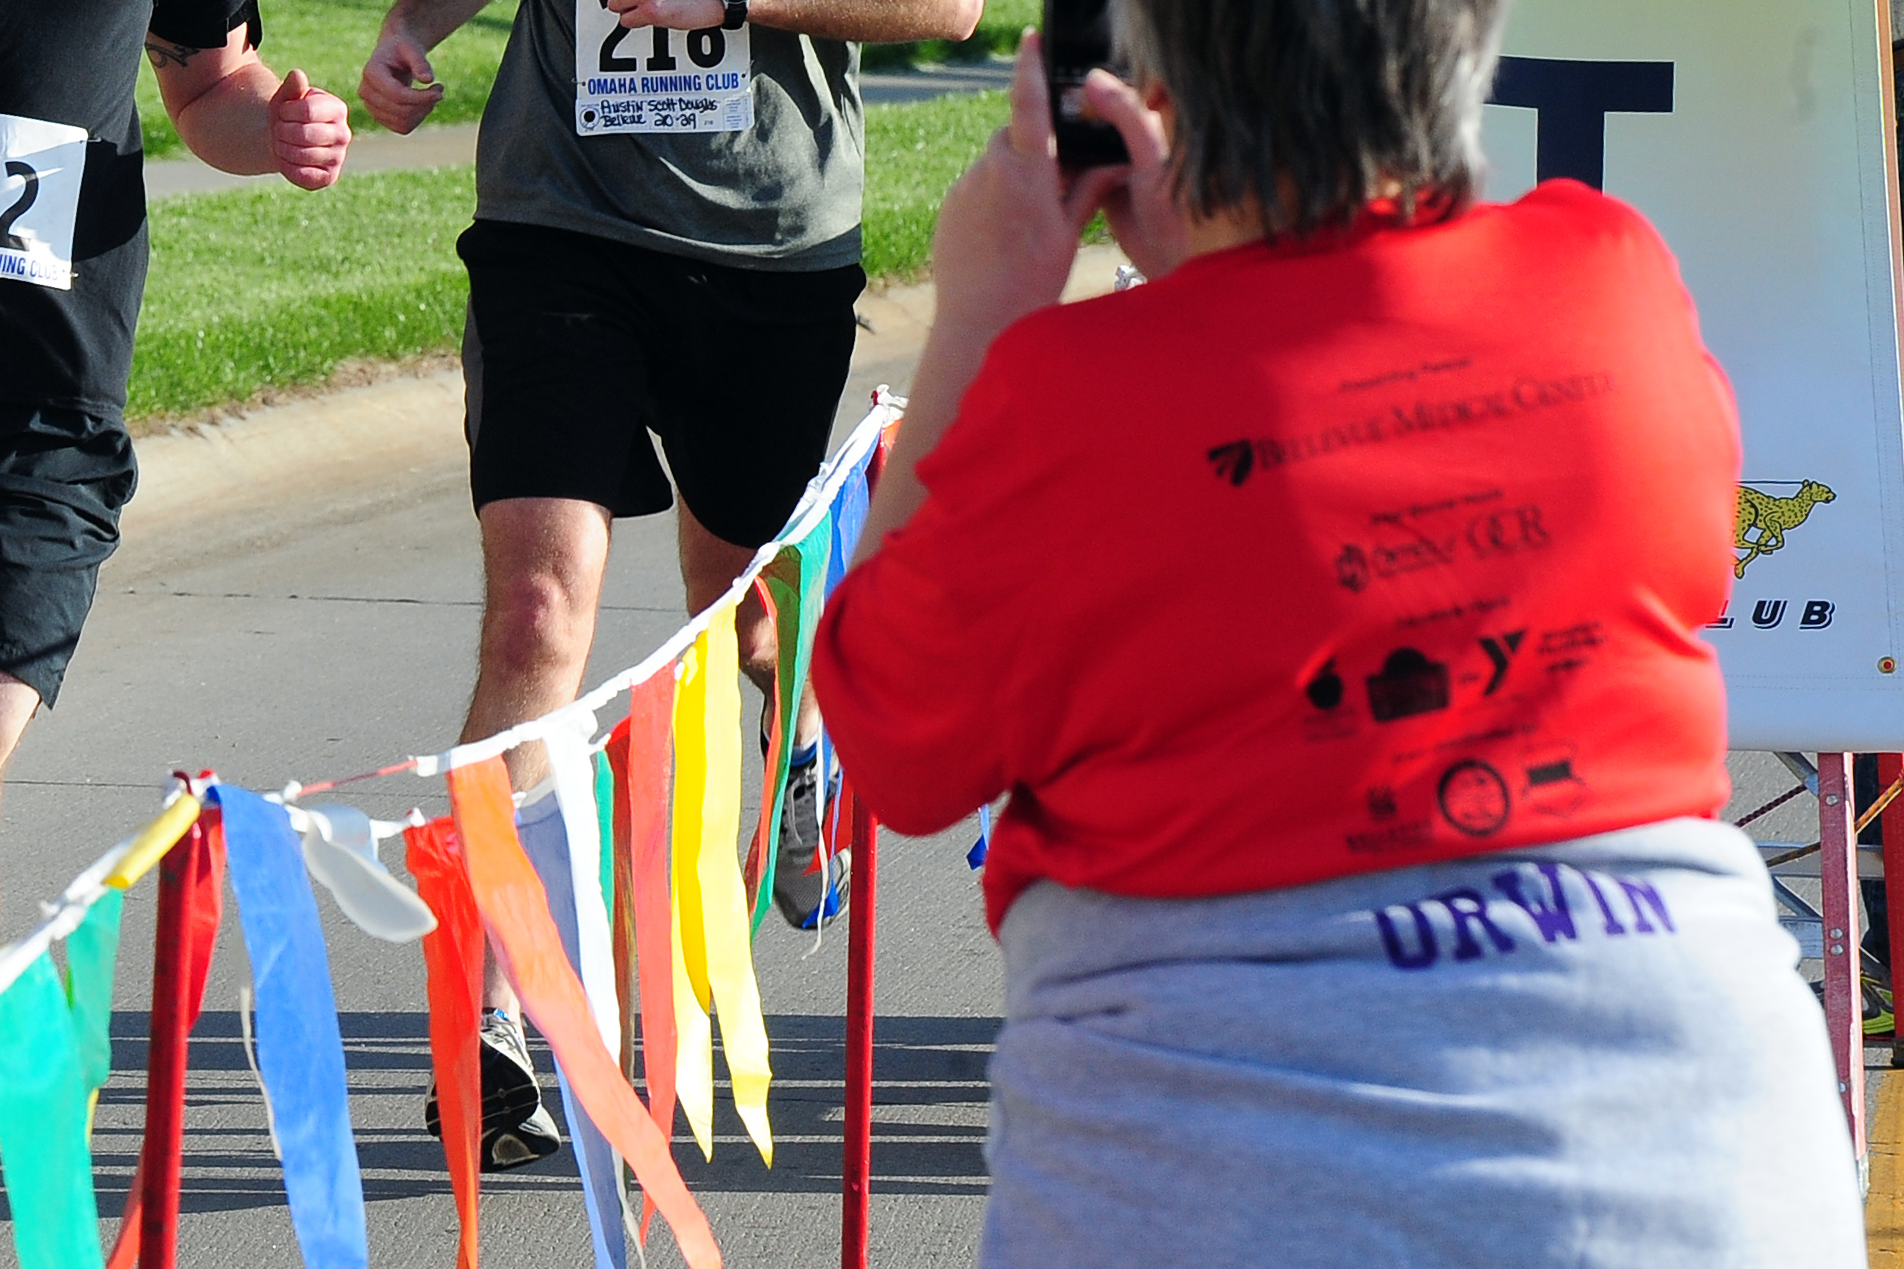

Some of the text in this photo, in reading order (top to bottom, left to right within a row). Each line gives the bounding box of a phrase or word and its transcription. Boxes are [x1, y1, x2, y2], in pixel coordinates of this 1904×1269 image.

[587, 72, 739, 95] OMAHA RUNNING CLUB
[1376, 862, 1674, 969] URWIN
